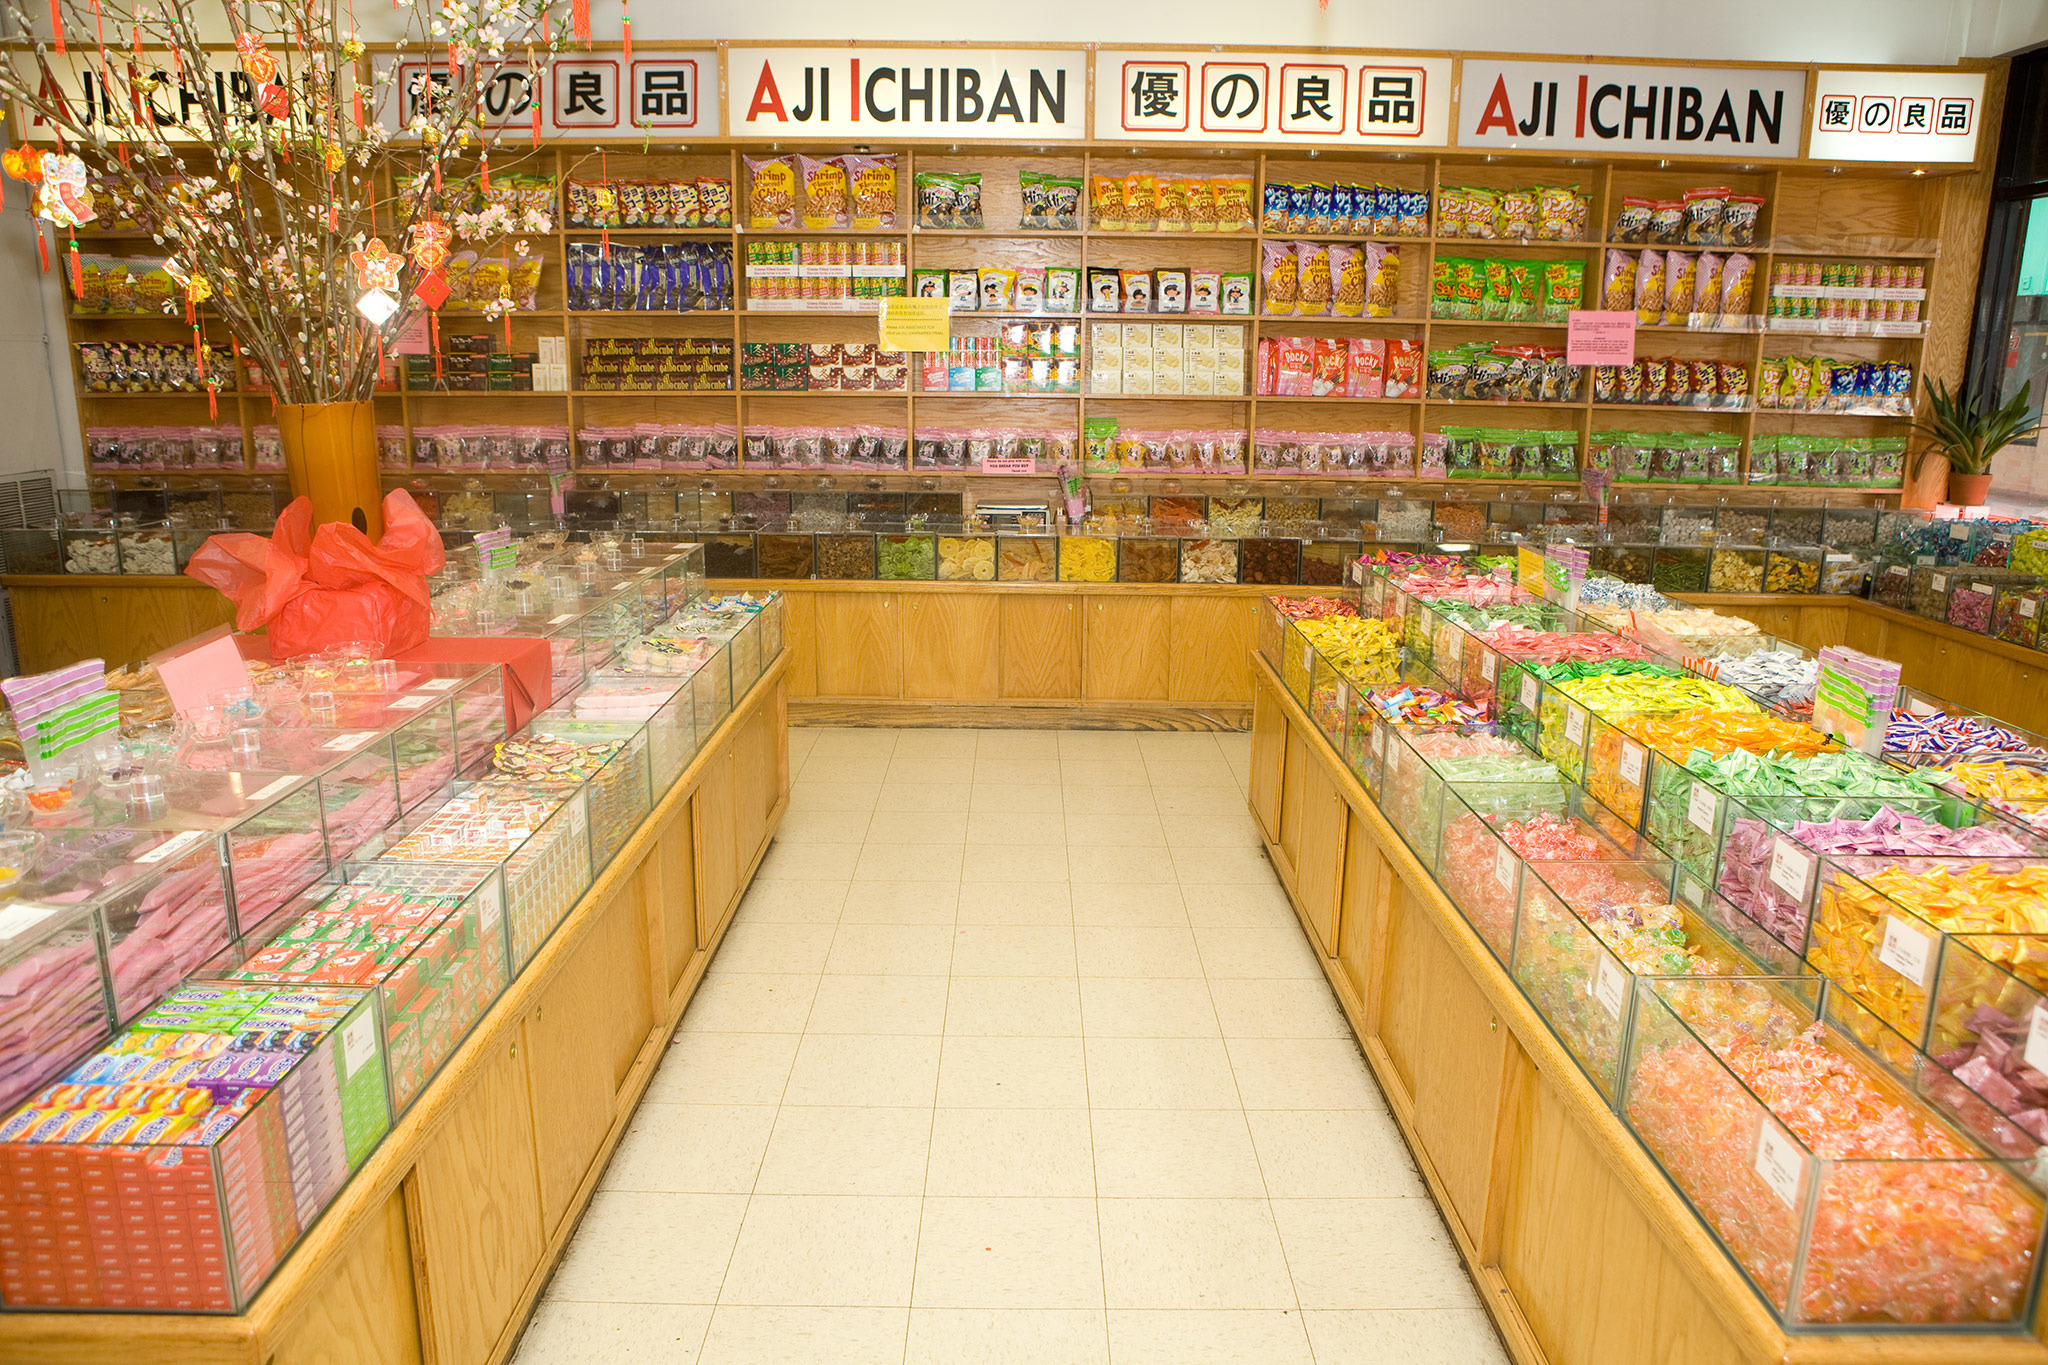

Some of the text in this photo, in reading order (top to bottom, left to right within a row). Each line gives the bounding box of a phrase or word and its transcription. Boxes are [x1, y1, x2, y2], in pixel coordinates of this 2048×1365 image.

[746, 58, 1066, 124] AJI ICHIBAN
[1131, 71, 1415, 125] 優の良品
[1475, 73, 1784, 145] AJI ICHIBAN
[1823, 99, 1970, 131] 優の良品
[807, 170, 843, 184] Shrimp
[854, 170, 891, 183] Shrimp
[1457, 282, 1482, 301] Saya
[1552, 283, 1580, 301] Saya
[173, 989, 224, 1001] HI-CHEW
[270, 993, 321, 1004] HI-CHEW
[156, 1003, 209, 1014] HI-CHEW
[255, 1006, 307, 1016] HI-CHEW
